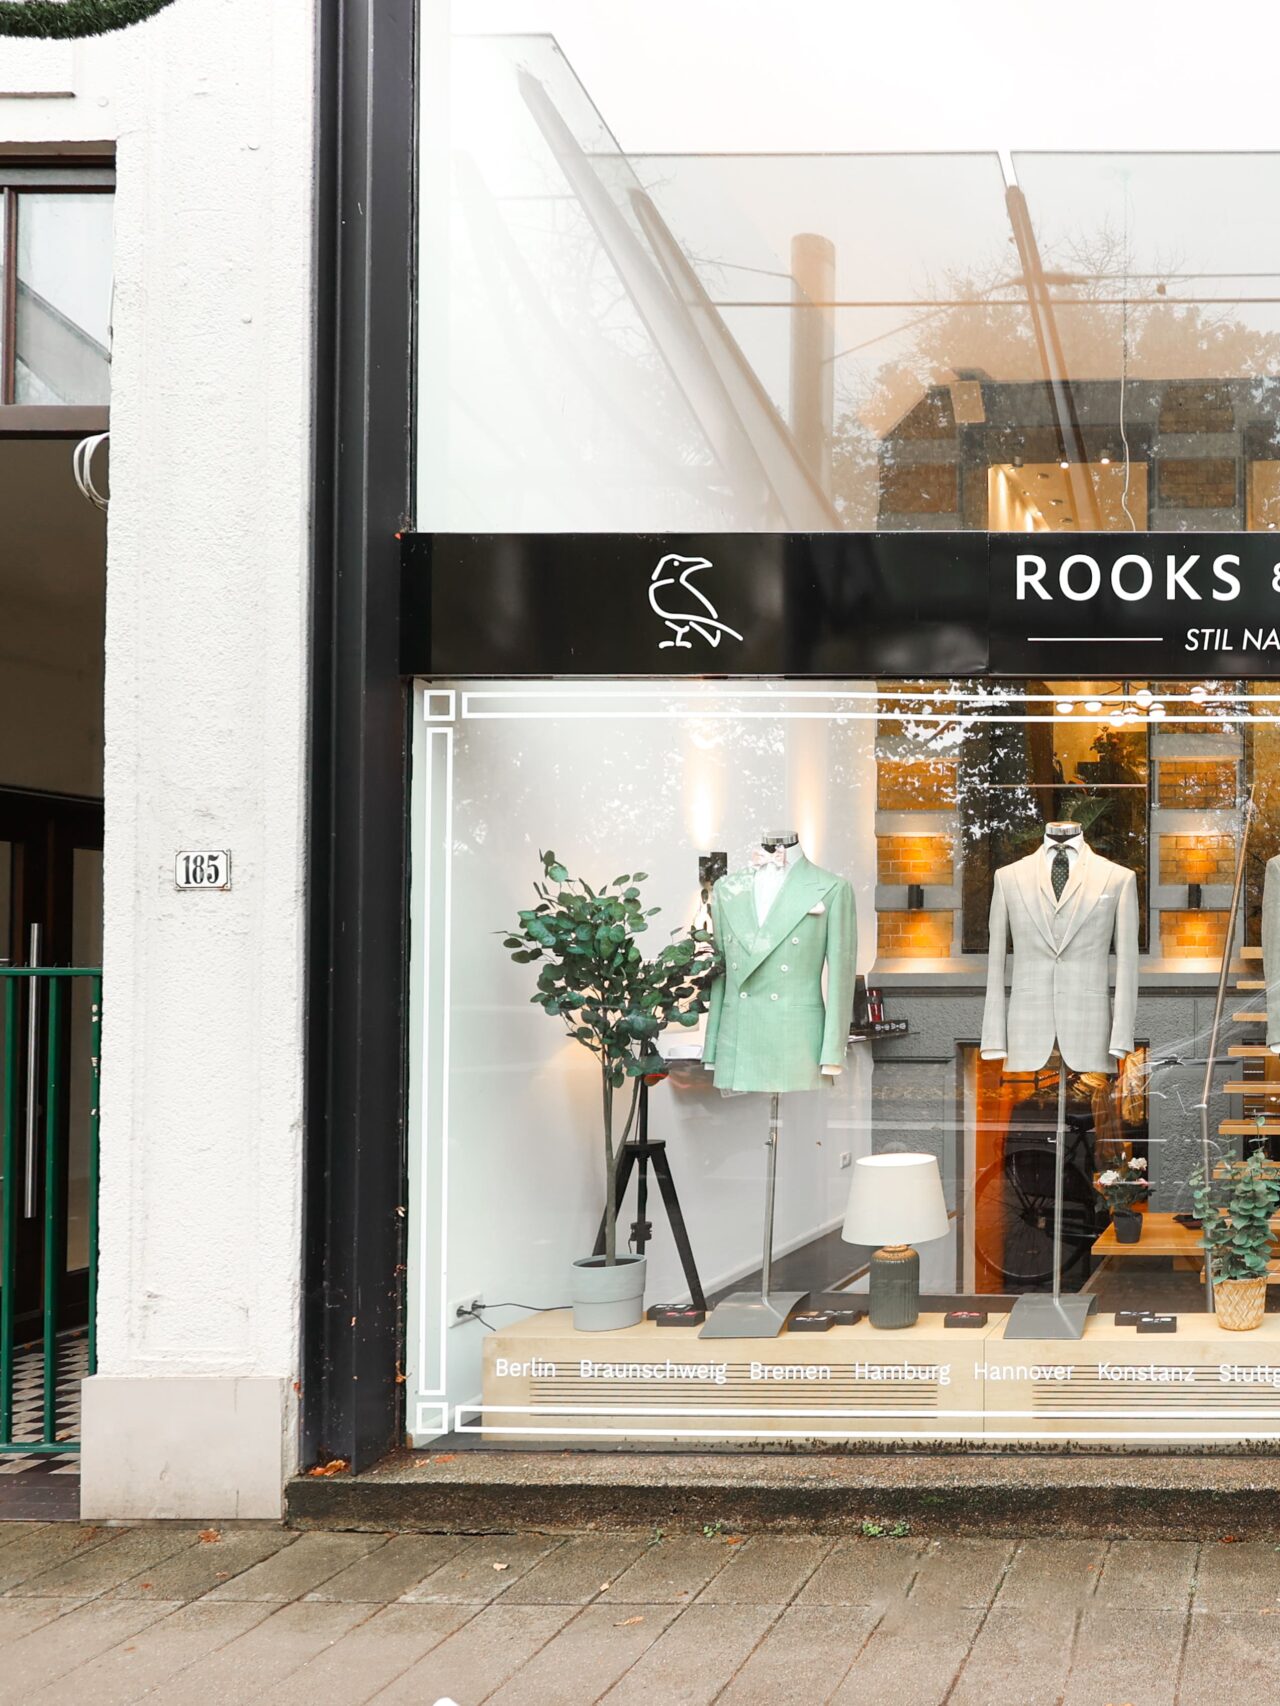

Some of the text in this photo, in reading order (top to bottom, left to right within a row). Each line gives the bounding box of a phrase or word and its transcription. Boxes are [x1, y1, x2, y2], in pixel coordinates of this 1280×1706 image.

[1015, 553, 1242, 602] ROOKS
[1184, 628, 1234, 652] STIL
[182, 854, 220, 885] 185
[495, 1357, 557, 1378] Berlin
[579, 1359, 728, 1385] Braunschweig
[749, 1361, 832, 1380] Bremen
[854, 1360, 951, 1386] Hamburg
[973, 1362, 1076, 1381] Hannover
[1097, 1362, 1196, 1382] Konstanz
